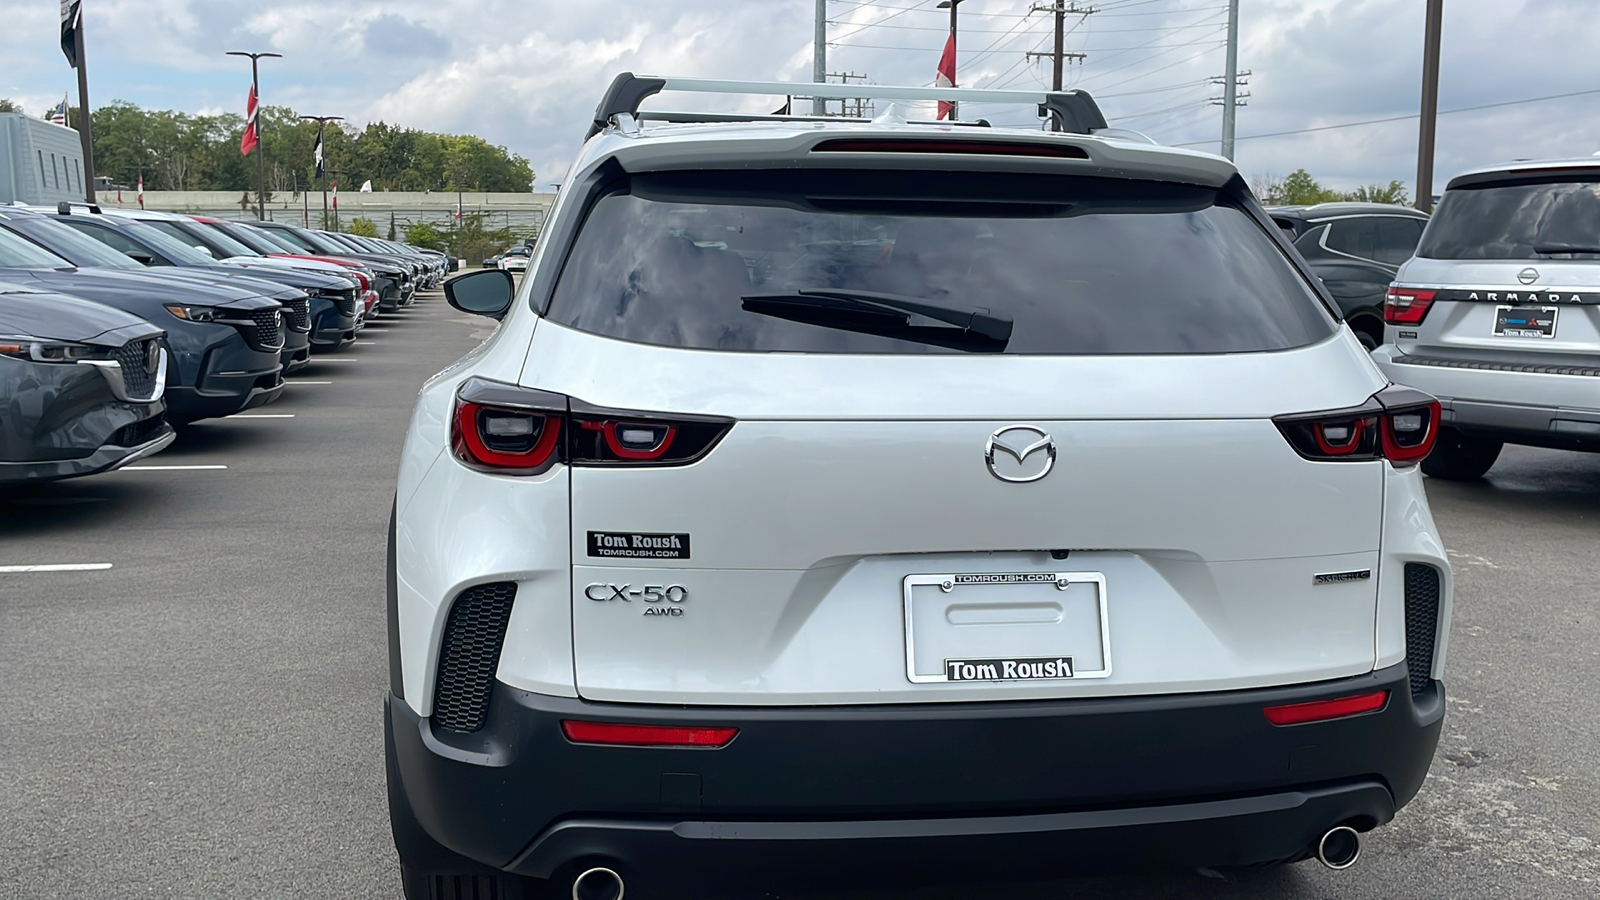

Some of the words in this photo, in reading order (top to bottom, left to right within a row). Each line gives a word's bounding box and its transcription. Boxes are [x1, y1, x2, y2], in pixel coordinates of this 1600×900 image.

[1468, 292, 1582, 303] ARMADA
[594, 534, 628, 547] Tom
[632, 535, 681, 548] Roush
[598, 549, 678, 557] TOMROUSH.COM
[956, 574, 1054, 582] TOMROUSH.COM
[584, 582, 688, 603] CX-50
[643, 606, 683, 616] AWD
[949, 662, 998, 680] Tom
[1002, 659, 1071, 678] Roush
